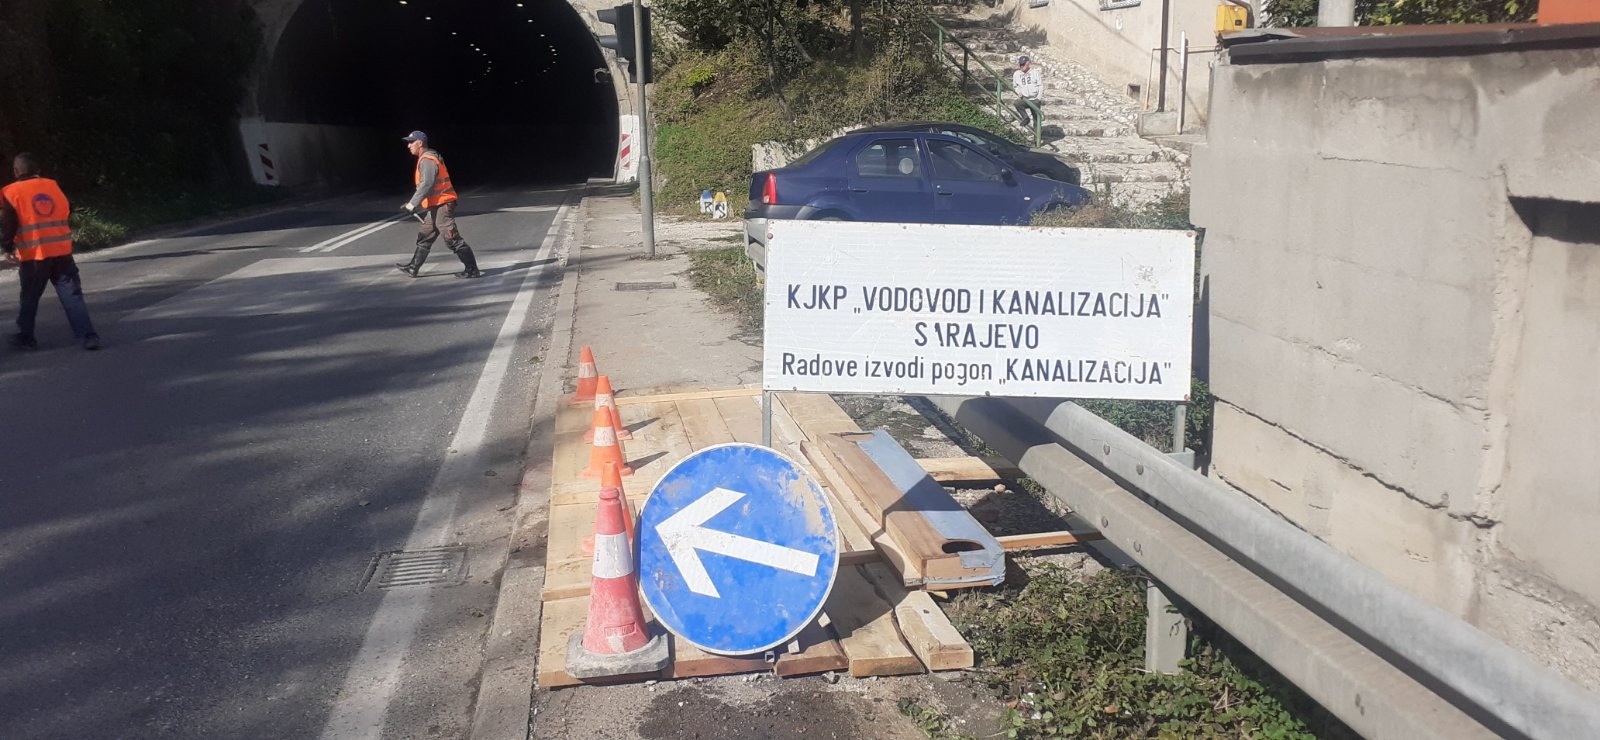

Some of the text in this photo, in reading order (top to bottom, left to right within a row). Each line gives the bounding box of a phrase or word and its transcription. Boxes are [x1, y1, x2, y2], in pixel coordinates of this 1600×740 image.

[1021, 77, 1032, 85] 82
[787, 284, 847, 310] KJKP
[979, 289, 984, 315] I
[782, 352, 858, 377] Radove
[865, 355, 924, 379] izvodi
[931, 362, 992, 386] pogon
